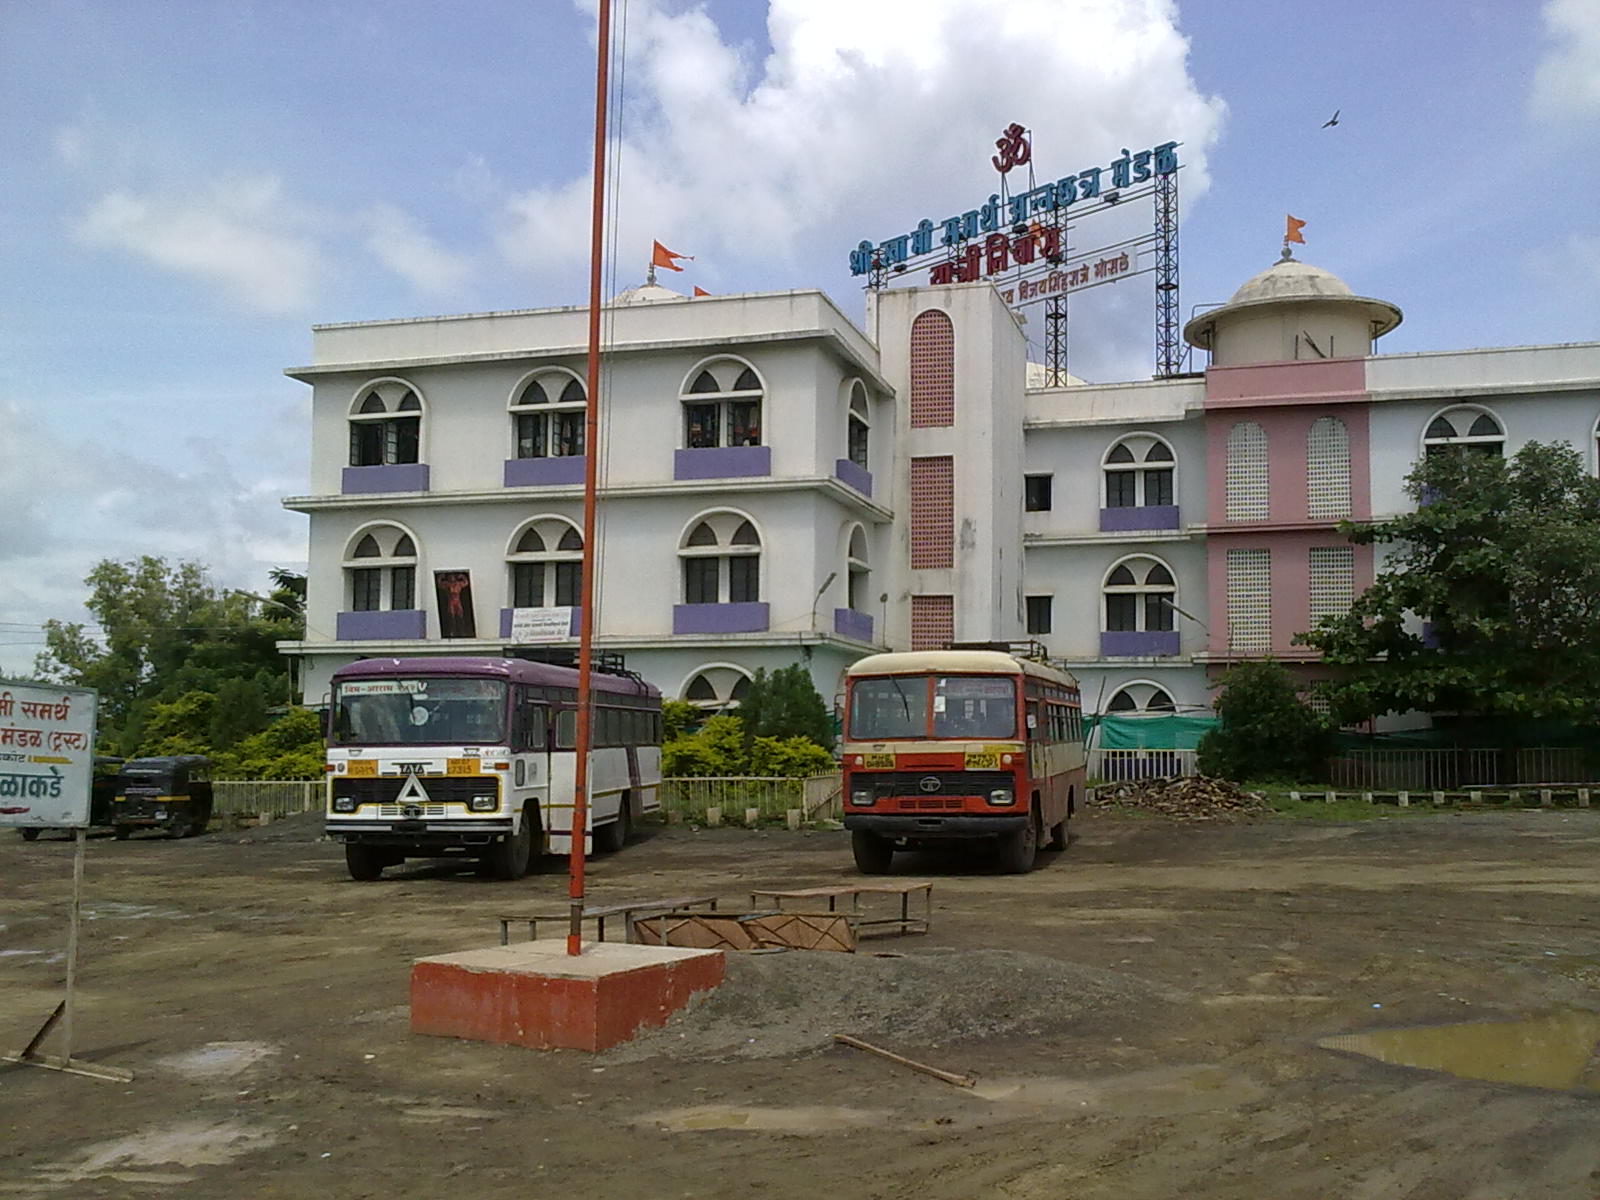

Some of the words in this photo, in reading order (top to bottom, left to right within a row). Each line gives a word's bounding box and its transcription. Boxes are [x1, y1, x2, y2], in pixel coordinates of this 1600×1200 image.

[0, 691, 16, 716] मी
[21, 696, 70, 721] समर्थ
[0, 750, 26, 763] कोट
[0, 766, 64, 798] ळाकडे
